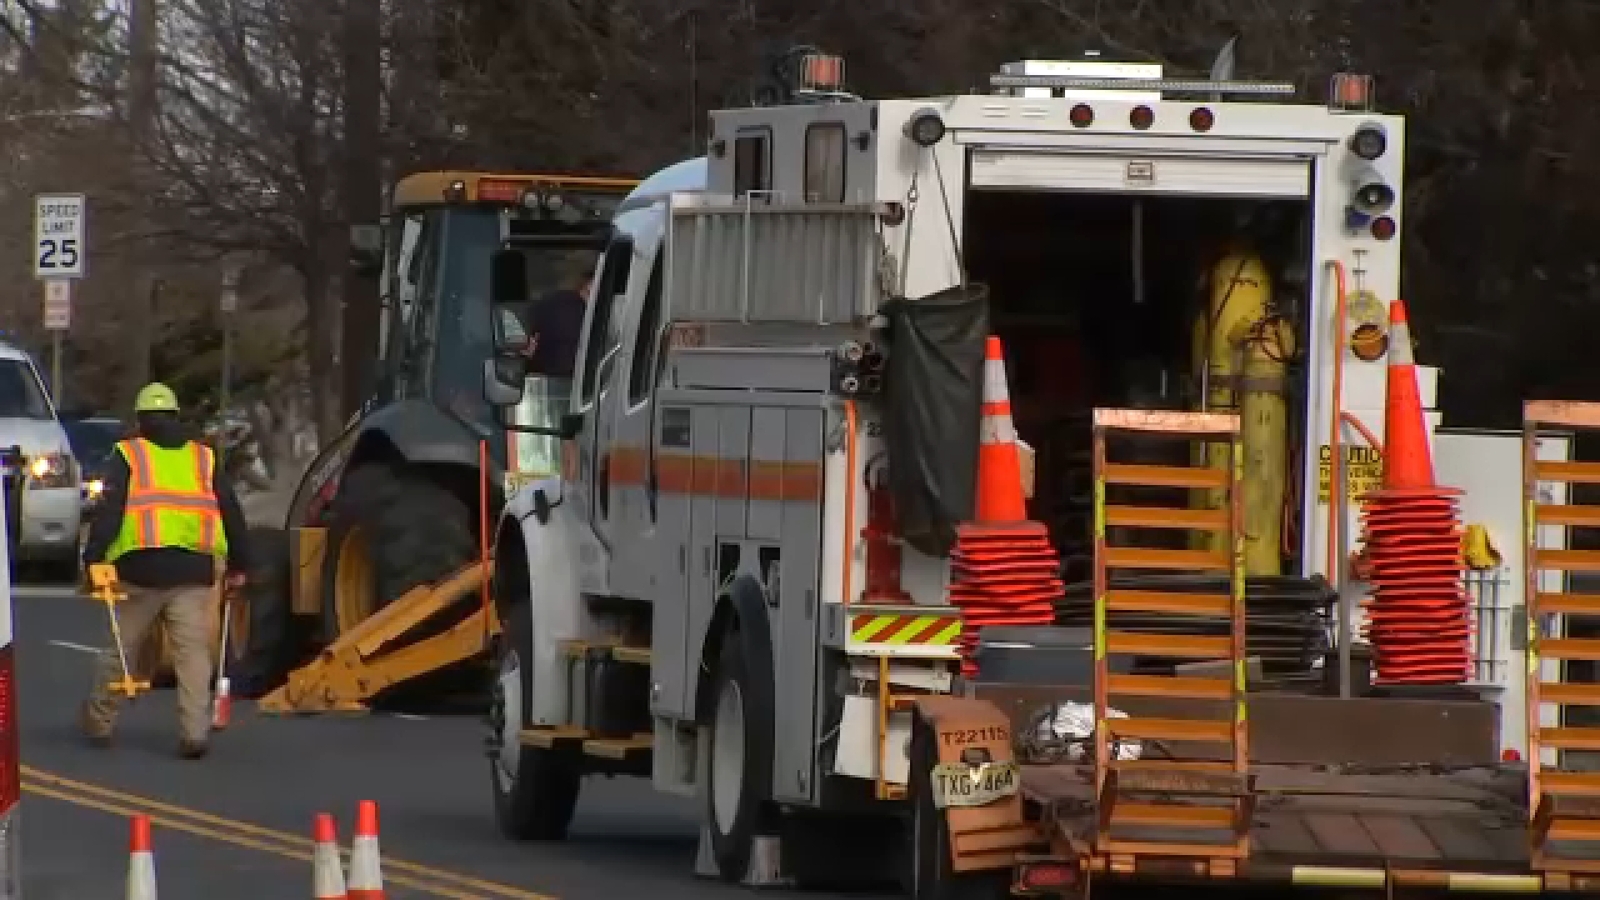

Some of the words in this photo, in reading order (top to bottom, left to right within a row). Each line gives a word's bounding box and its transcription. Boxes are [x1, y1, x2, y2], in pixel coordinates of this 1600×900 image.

[39, 204, 80, 218] SPEED
[42, 219, 75, 235] LIMIT
[40, 239, 78, 268] 25
[940, 726, 1008, 745] T22115
